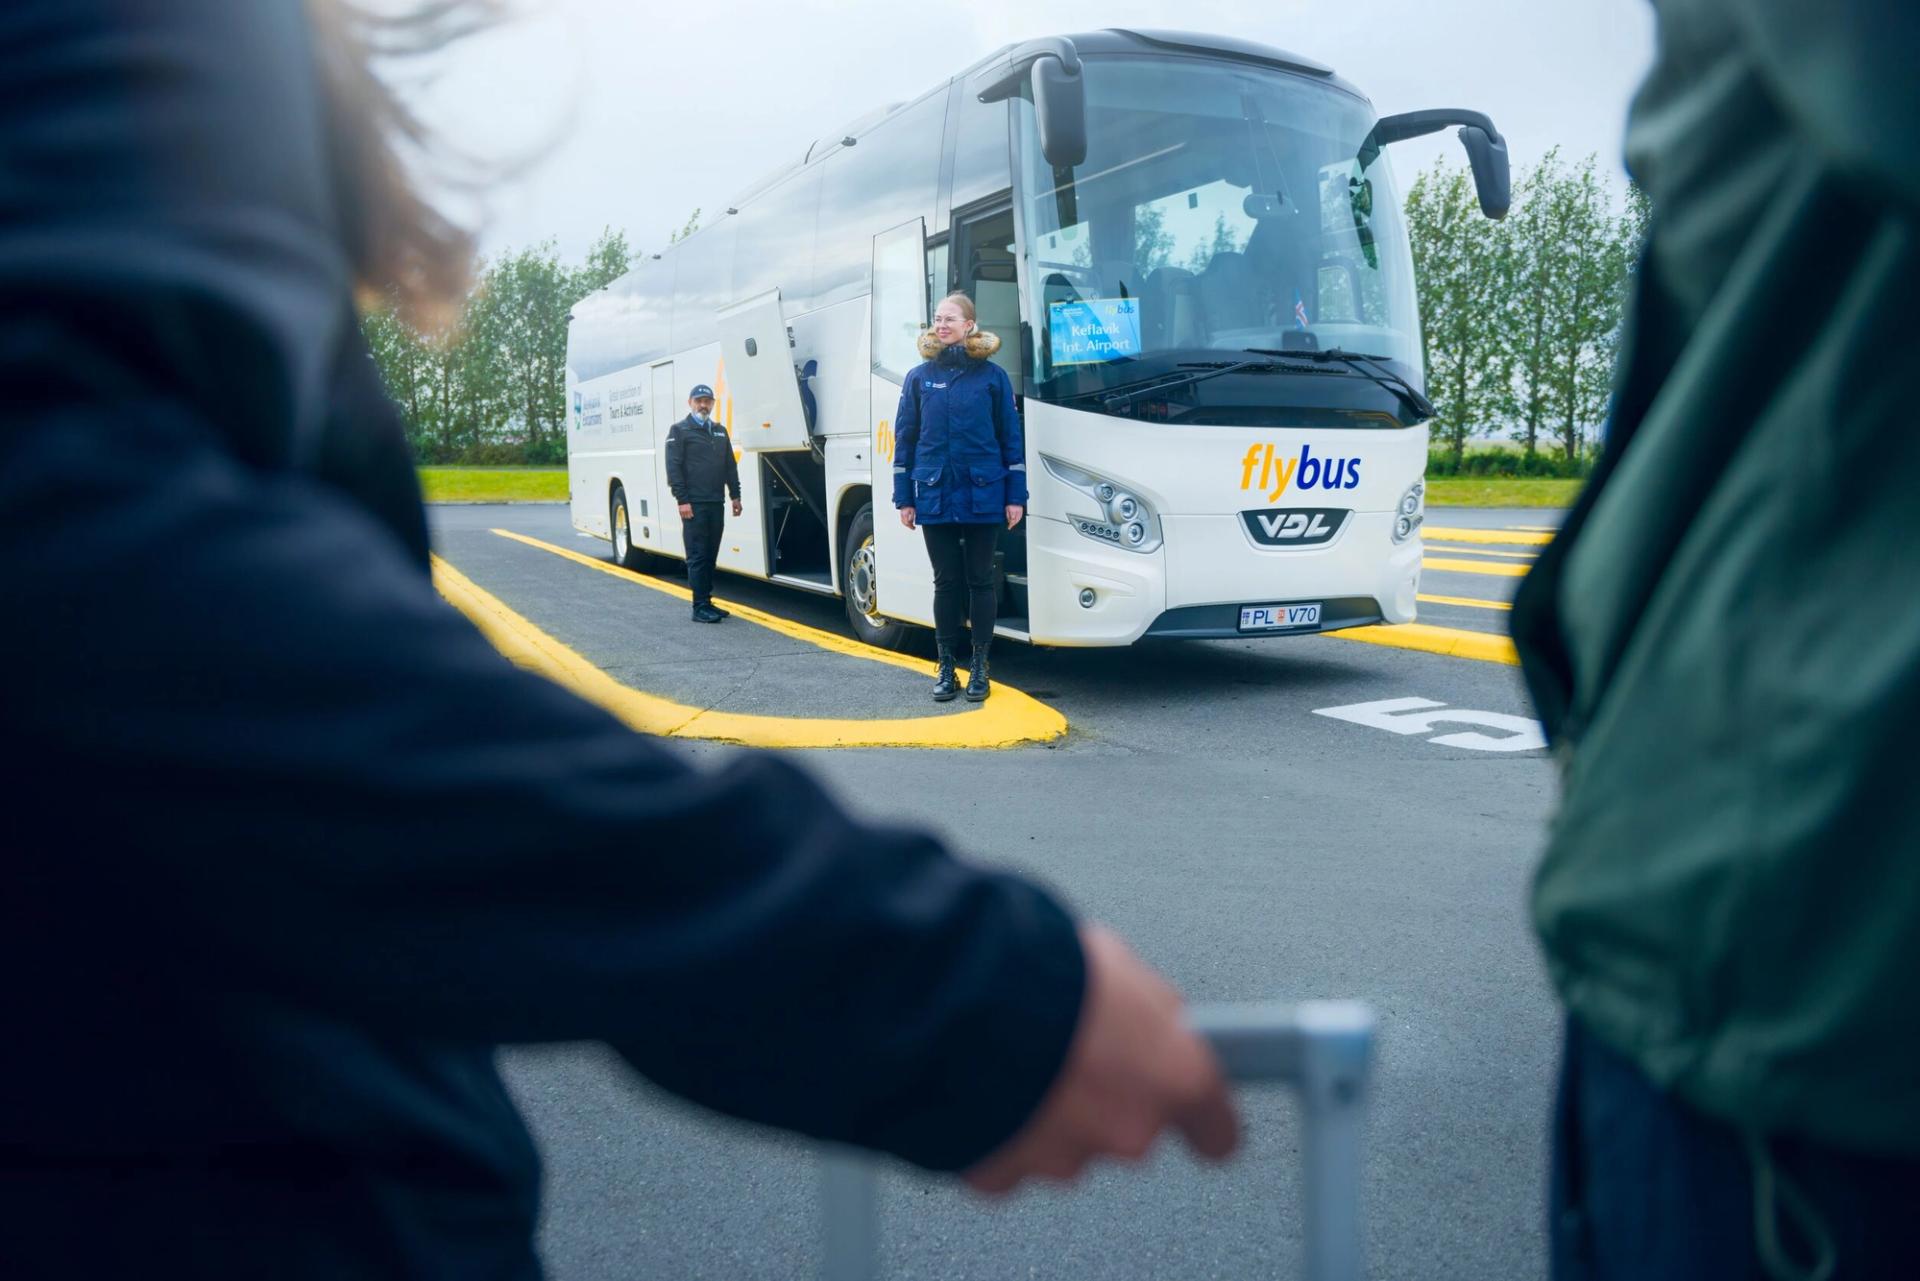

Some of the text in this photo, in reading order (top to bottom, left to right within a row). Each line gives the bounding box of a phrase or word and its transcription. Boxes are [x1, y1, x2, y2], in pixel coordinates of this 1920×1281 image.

[1062, 339, 1131, 354] Int. Airport
[877, 420, 895, 464] fly
[1240, 442, 1361, 503] flybus
[1257, 513, 1331, 538] VDL
[1252, 610, 1273, 625] PL
[1288, 607, 1317, 623] V70
[1311, 696, 1547, 751] 5
